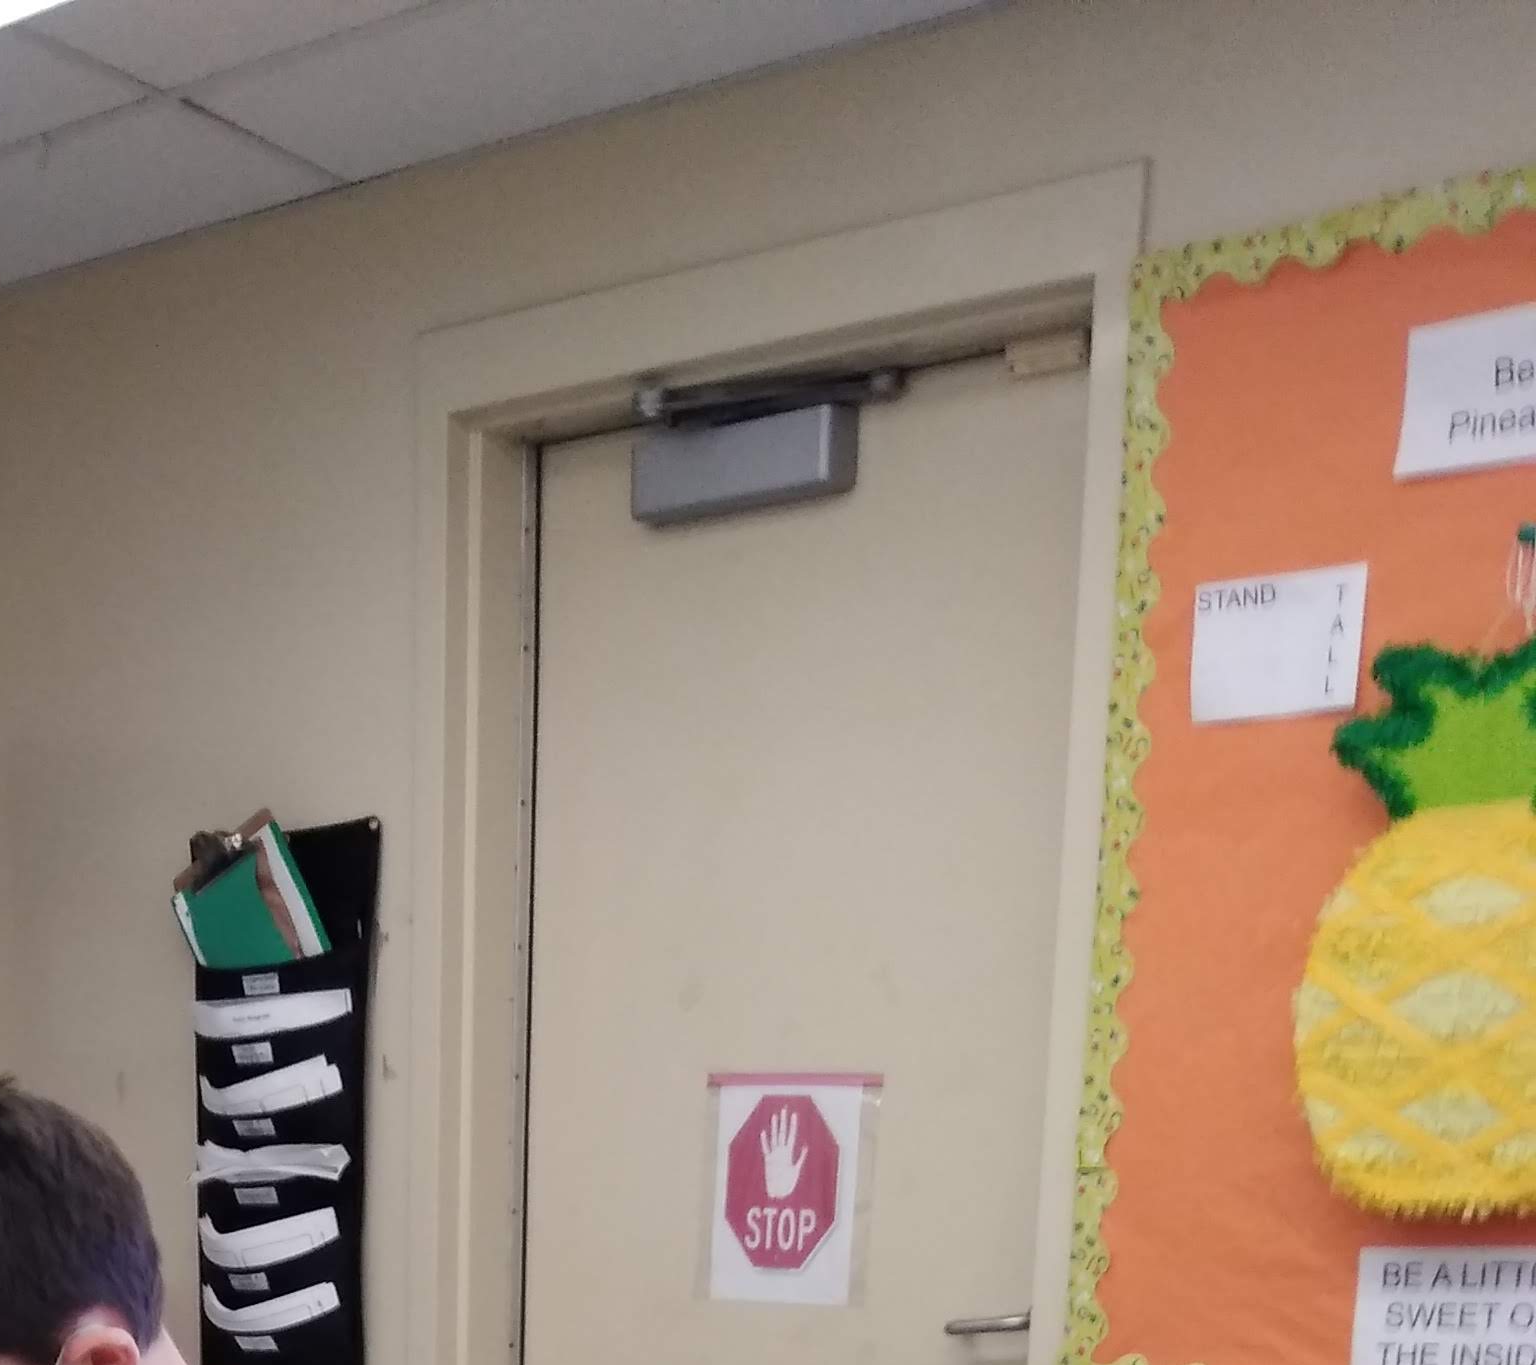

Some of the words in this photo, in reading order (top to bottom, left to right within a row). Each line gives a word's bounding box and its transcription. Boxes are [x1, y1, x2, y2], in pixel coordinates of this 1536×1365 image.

[1495, 356, 1535, 388] Be
[1449, 405, 1536, 445] Pinea
[1197, 582, 1277, 612] STAND
[1324, 583, 1347, 695] TALL
[744, 1206, 816, 1252] STOP
[1381, 1260, 1424, 1288] BE
[1431, 1262, 1454, 1289] A
[1460, 1260, 1536, 1288] LITT
[1385, 1302, 1501, 1329] SWEET
[1509, 1302, 1536, 1329] O
